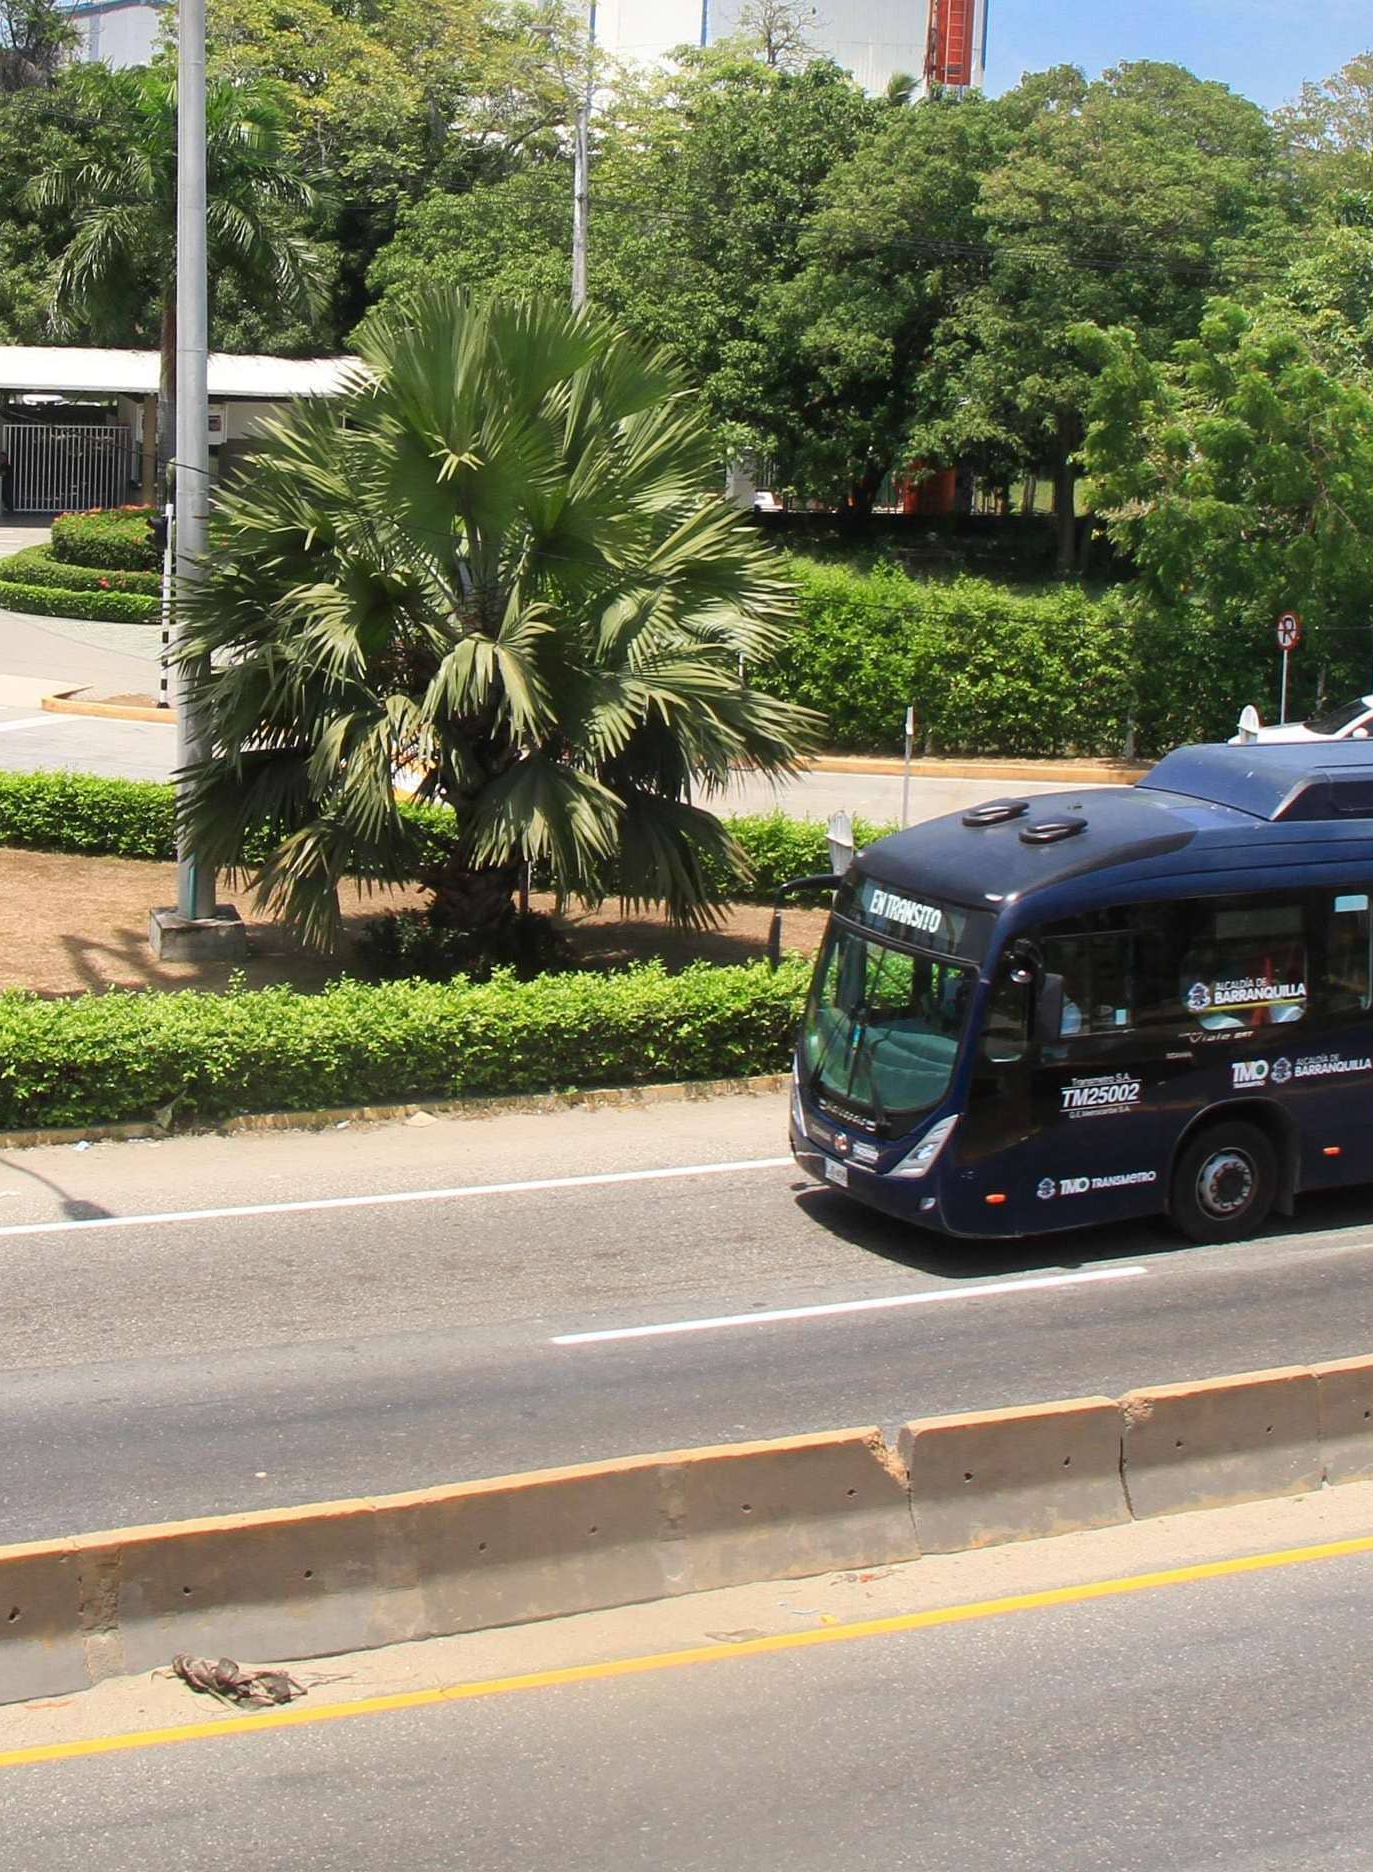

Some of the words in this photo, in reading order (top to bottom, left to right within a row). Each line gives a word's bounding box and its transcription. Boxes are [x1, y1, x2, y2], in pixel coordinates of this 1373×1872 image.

[868, 889, 888, 916] EN
[884, 893, 943, 934] TRANSITO
[1214, 977, 1255, 991] ALCALDÍA
[1255, 976, 1268, 987] DE
[1214, 982, 1307, 1005] BARRANQUILLA
[1231, 1059, 1270, 1082] TMO
[1294, 1058, 1373, 1077] BARRANQUILLA
[1061, 1083, 1140, 1108] TM25002
[1059, 1176, 1090, 1196] TMO
